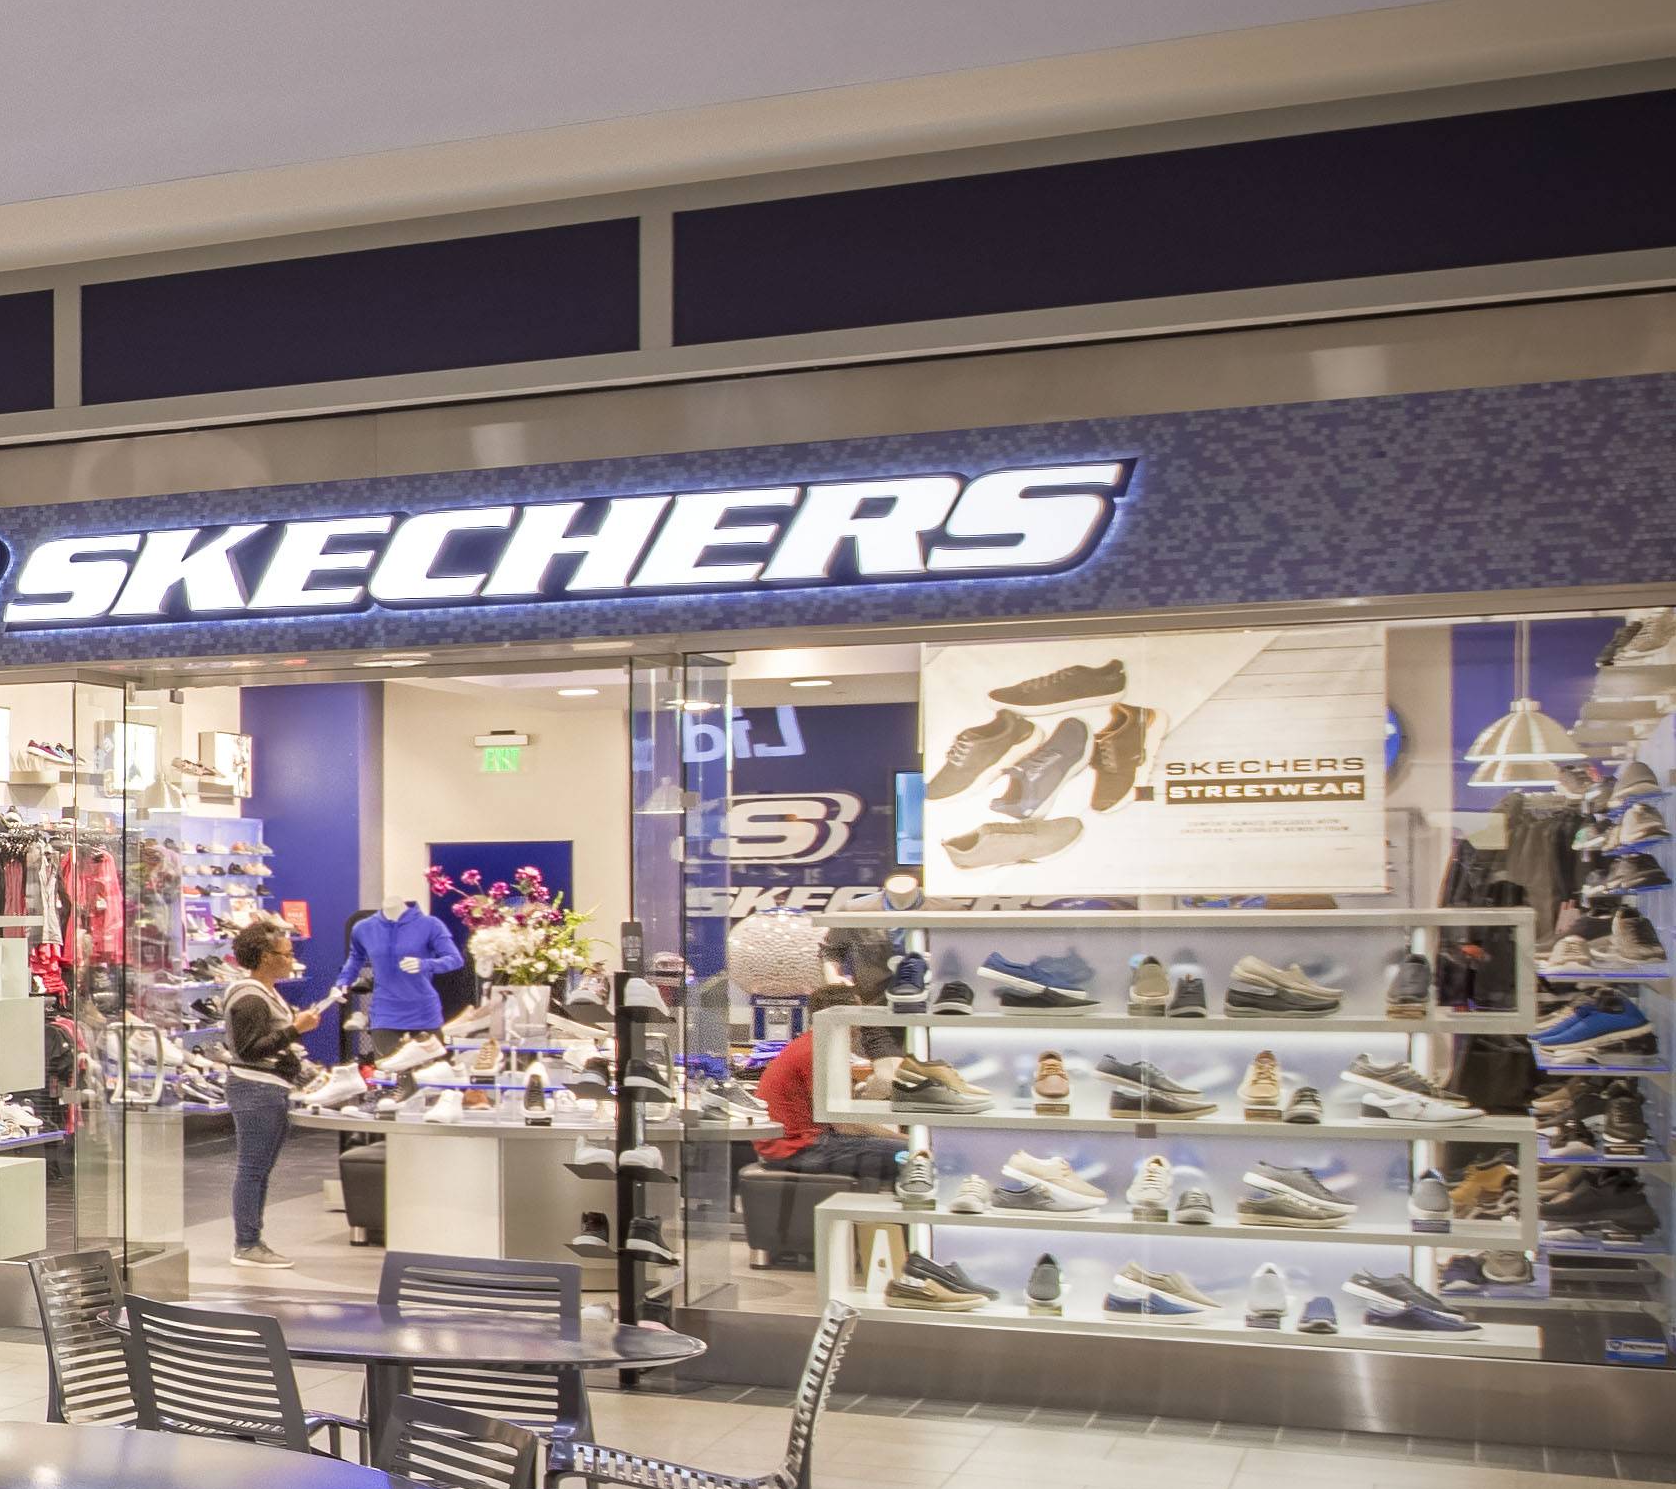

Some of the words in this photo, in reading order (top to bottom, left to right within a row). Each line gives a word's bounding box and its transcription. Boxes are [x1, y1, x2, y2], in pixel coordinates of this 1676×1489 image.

[4, 462, 1126, 623] SKECHERS
[1166, 757, 1365, 776] SKECHERS
[1168, 781, 1362, 799] STREETWEAR
